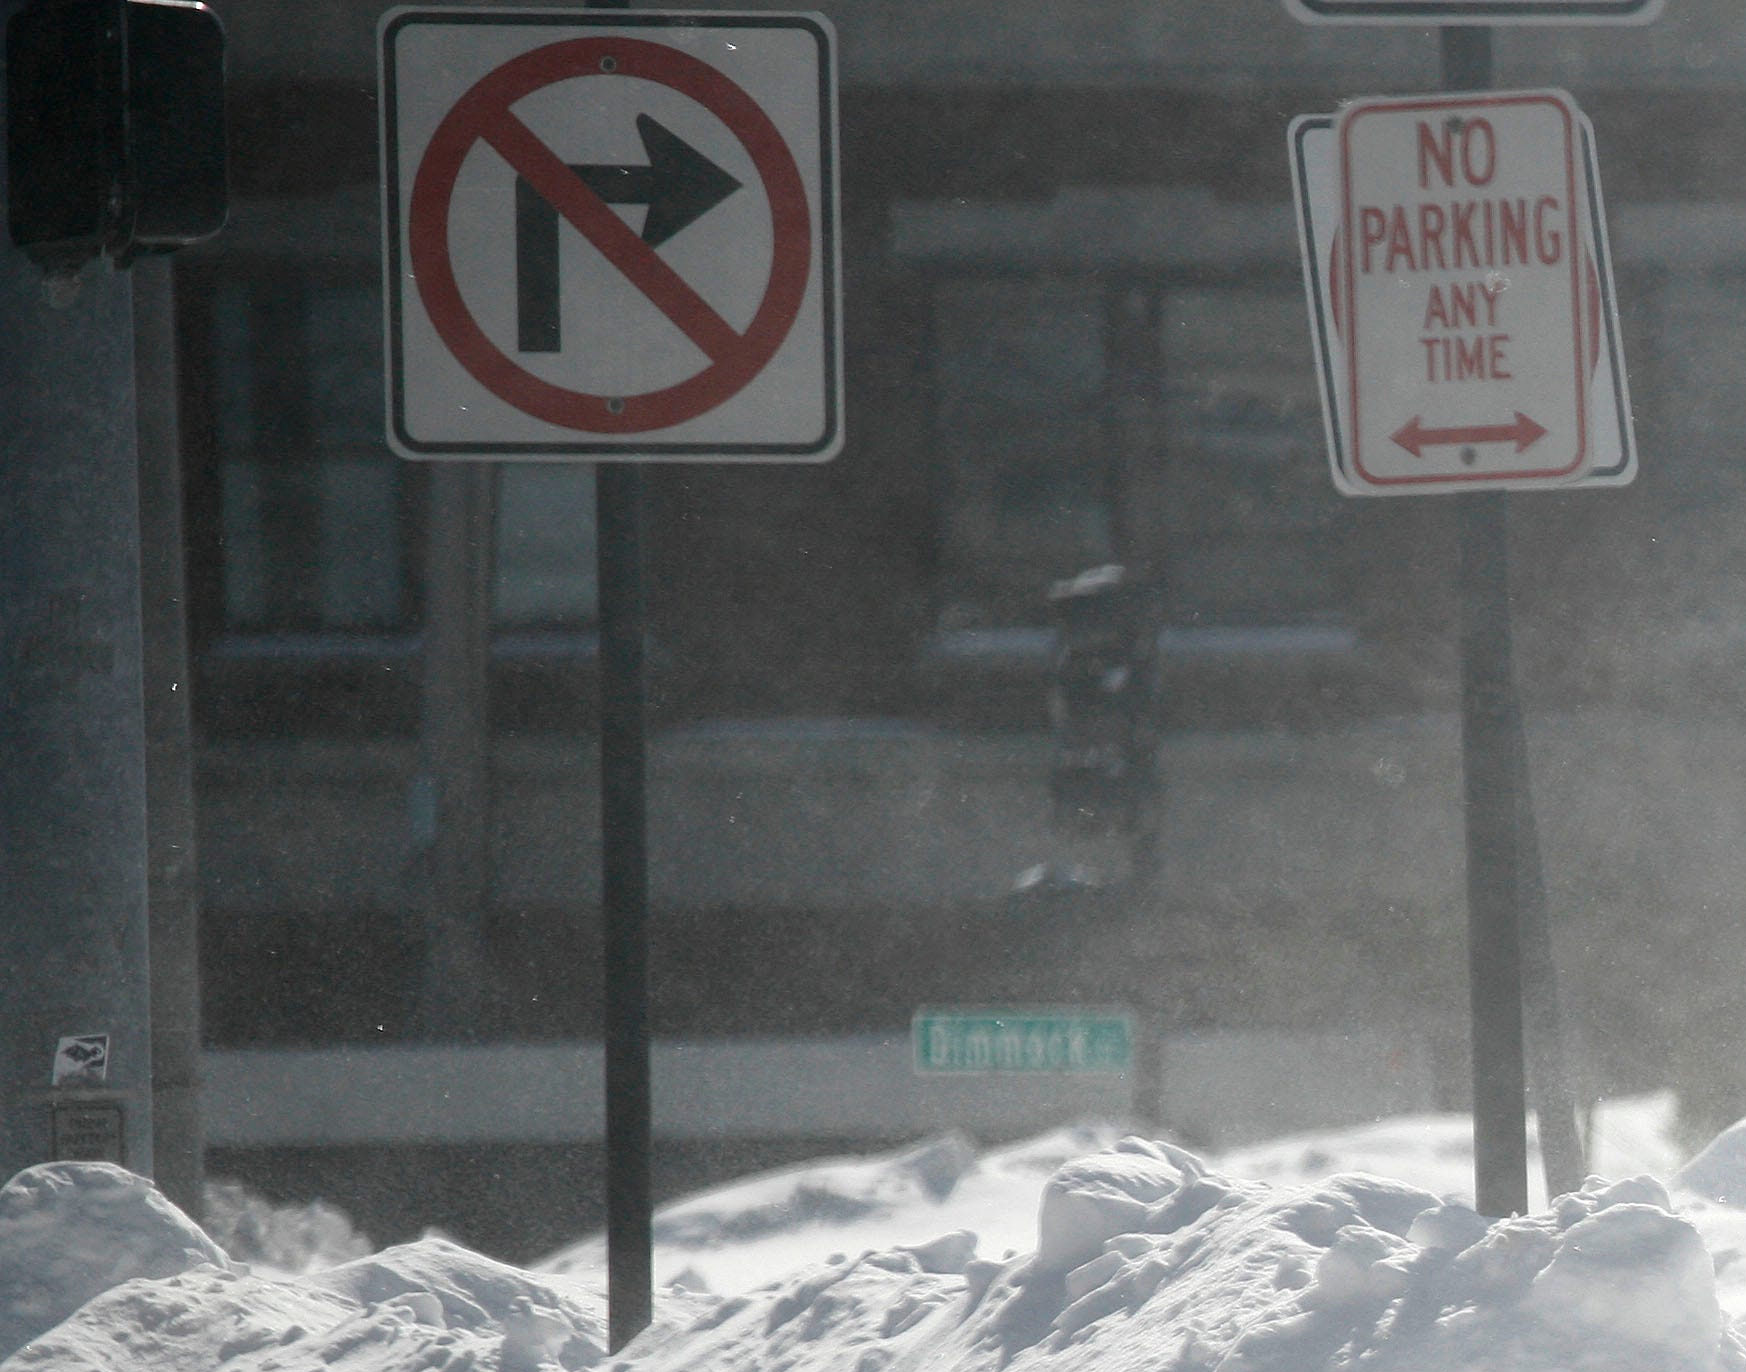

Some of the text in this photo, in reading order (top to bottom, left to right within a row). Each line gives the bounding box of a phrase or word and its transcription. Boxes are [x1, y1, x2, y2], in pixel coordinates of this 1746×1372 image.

[1417, 118, 1496, 188] NO
[1361, 196, 1561, 273] PARKING
[1425, 281, 1499, 328] ANY
[1421, 335, 1511, 381] TIME
